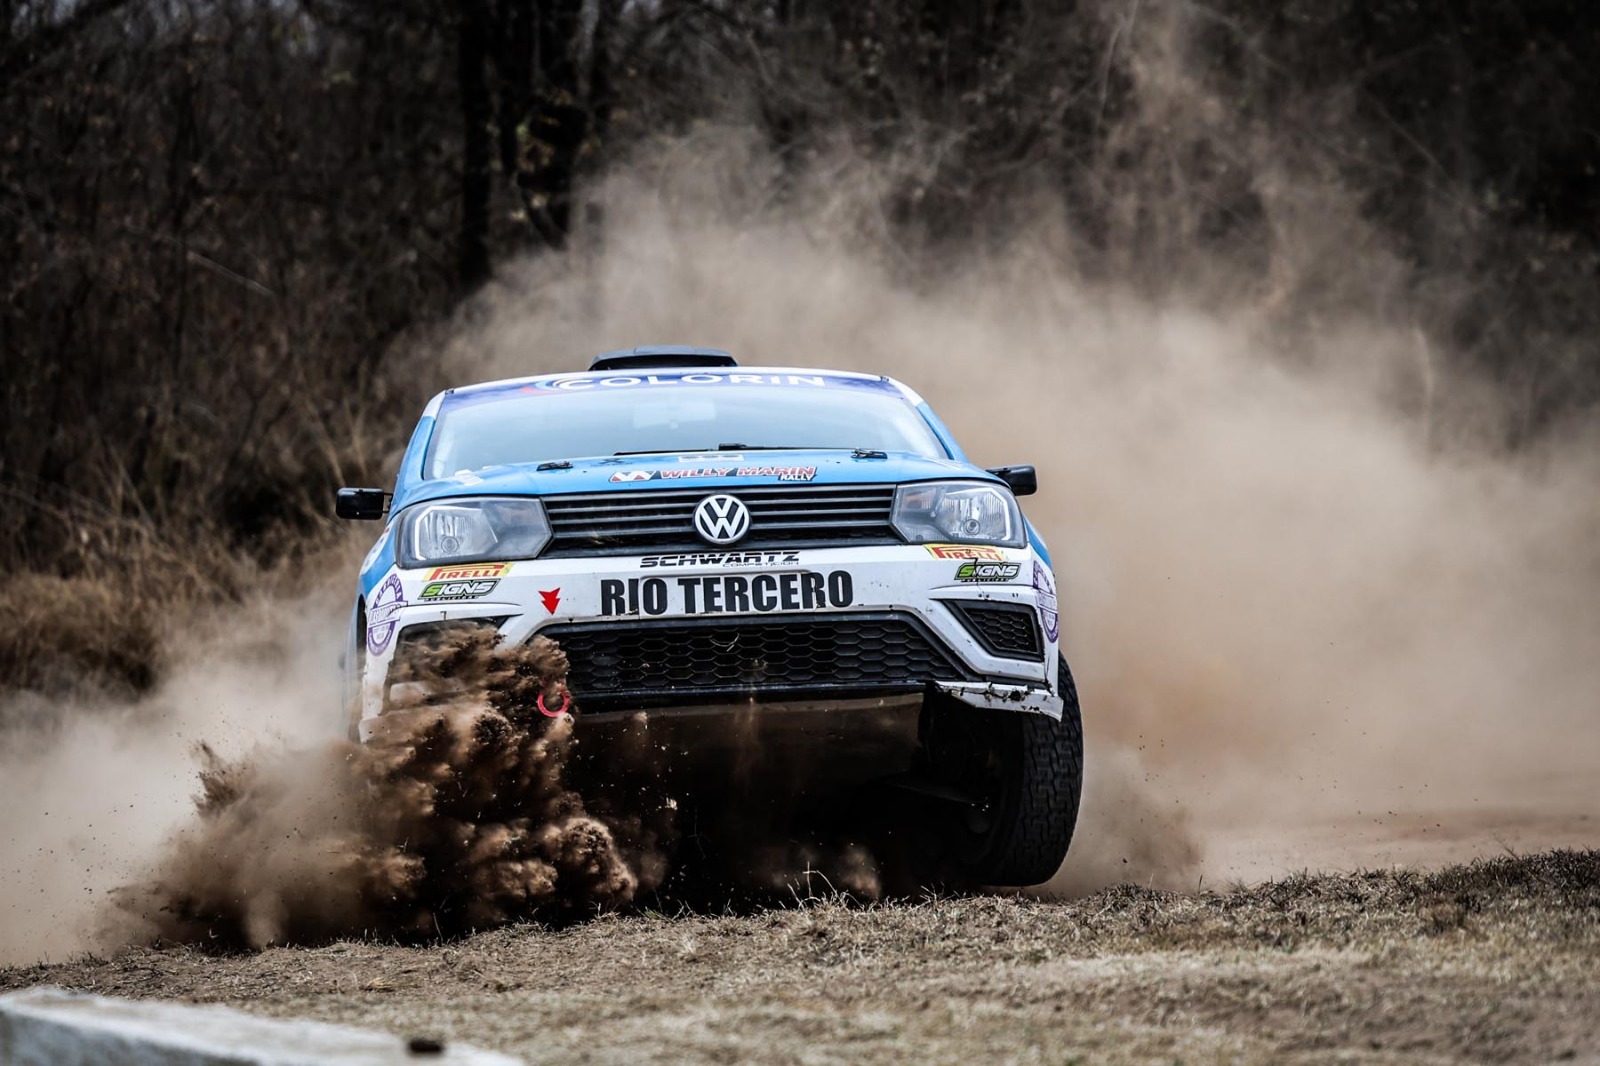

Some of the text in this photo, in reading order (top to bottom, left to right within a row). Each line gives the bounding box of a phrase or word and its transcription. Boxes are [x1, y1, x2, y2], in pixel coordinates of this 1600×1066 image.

[555, 374, 826, 390] COLORIN
[661, 468, 733, 479] WILLY
[737, 466, 815, 477] MARIN
[695, 494, 749, 544] VW
[640, 551, 799, 567] SCHWARTZ
[931, 546, 1002, 561] PIRELLI
[430, 564, 505, 581] PIRELLI
[958, 565, 1018, 577] SIGNS
[424, 582, 495, 596] SIGNS
[600, 570, 853, 616] RIO TERCERO
